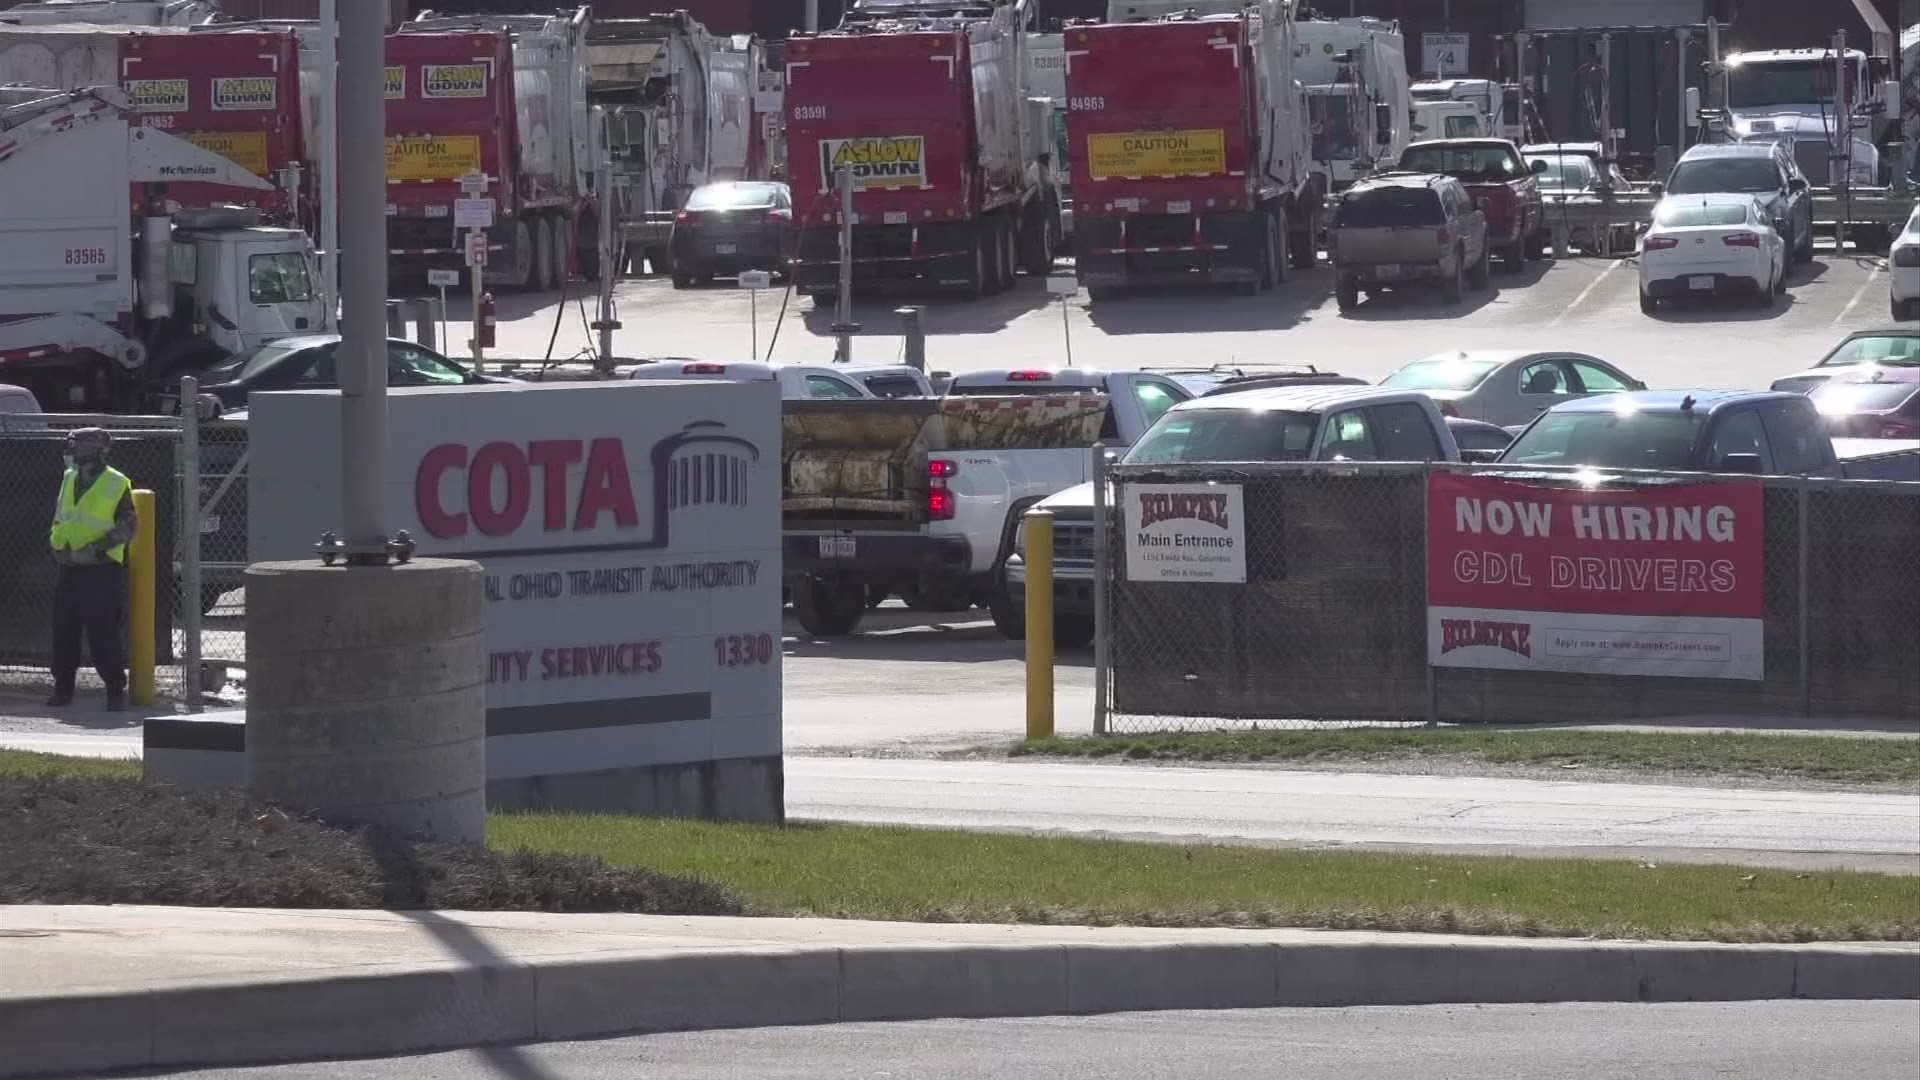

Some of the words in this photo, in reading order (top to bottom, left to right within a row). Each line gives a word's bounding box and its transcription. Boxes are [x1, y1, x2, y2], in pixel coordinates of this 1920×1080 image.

[384, 142, 446, 156] CAUTION
[1123, 137, 1189, 151] CAUTION
[65, 248, 106, 265] 83585
[415, 437, 640, 540] COTA
[1455, 497, 1553, 538] NOW
[1572, 505, 1736, 543] HIRING
[1138, 533, 1171, 547] Main
[1175, 533, 1234, 548] Entrance
[509, 571, 563, 601] OHIO
[566, 566, 647, 596] TRANSIT
[651, 559, 761, 592] AUTHORITY
[1454, 550, 1531, 586] CDL
[1551, 556, 1736, 592] DRIVERS
[714, 632, 773, 667] 1330
[1441, 618, 1531, 659] RUMPKE
[1554, 636, 1578, 649] Apply
[487, 649, 533, 683] ITY
[541, 640, 662, 681] SERVICES
